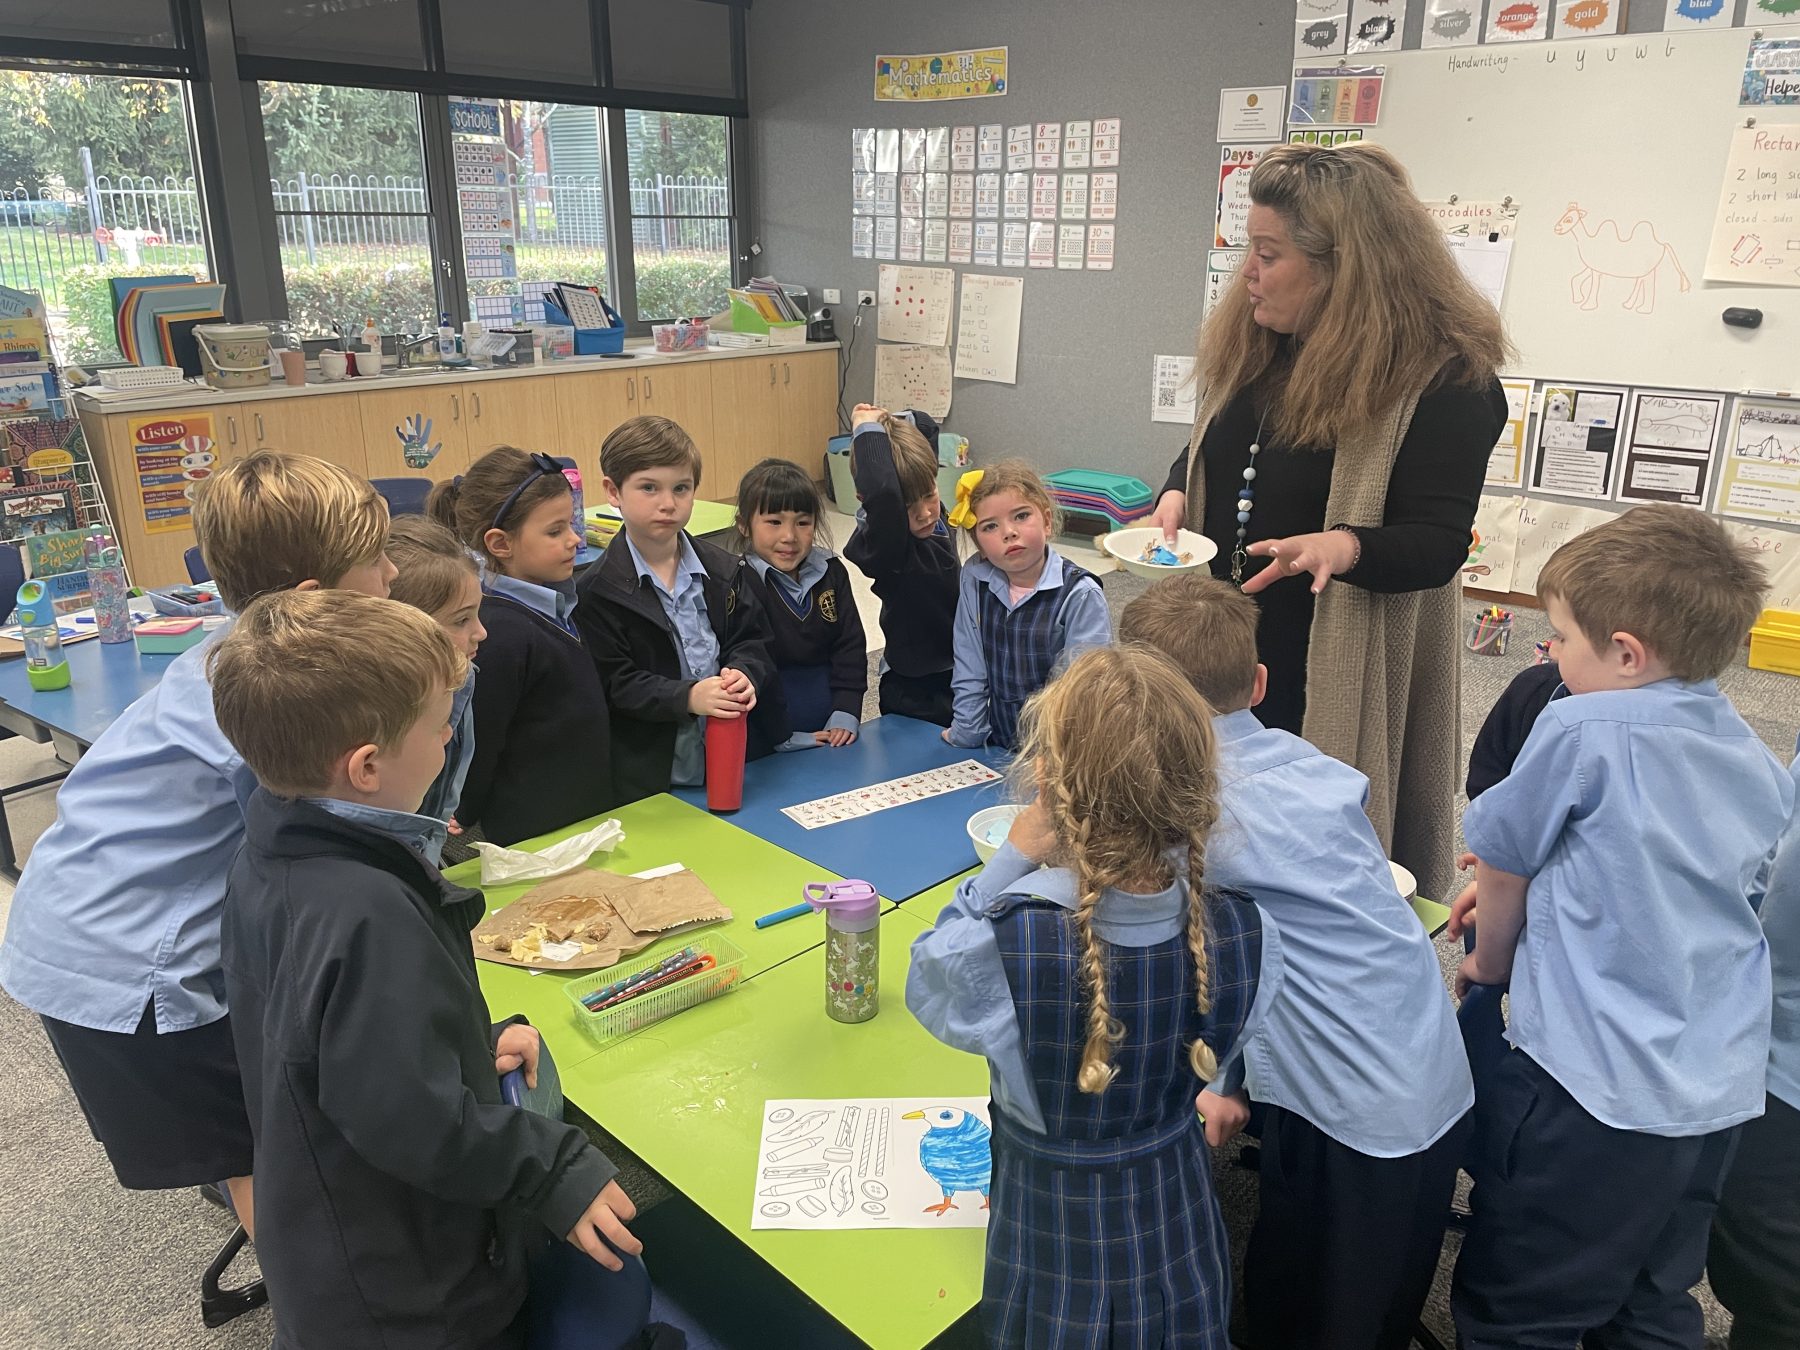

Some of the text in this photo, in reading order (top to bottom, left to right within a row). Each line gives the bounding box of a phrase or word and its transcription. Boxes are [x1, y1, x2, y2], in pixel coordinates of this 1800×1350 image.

[1689, 0, 1713, 8] blue
[1500, 12, 1535, 23] orange
[1574, 7, 1599, 21] gold
[1365, 23, 1388, 34] black
[1439, 18, 1465, 29] silver
[1311, 29, 1330, 39] grey
[1449, 54, 1508, 73] Handwriting
[1576, 49, 1586, 72] y
[889, 66, 993, 87] Mathematics
[454, 110, 495, 130] SCHOOL
[1223, 147, 1254, 165] Days
[1736, 168, 1746, 181] 2
[1757, 166, 1777, 184] long
[1728, 192, 1737, 205] 2
[1746, 189, 1777, 203] short
[1725, 210, 1758, 224] closed
[1211, 273, 1219, 285] 4
[1210, 289, 1218, 300] 3
[15, 381, 37, 392] Sock
[140, 425, 184, 440] Listen
[1551, 517, 1570, 530] cat
[1484, 533, 1502, 542] mat
[40, 553, 62, 568] Big
